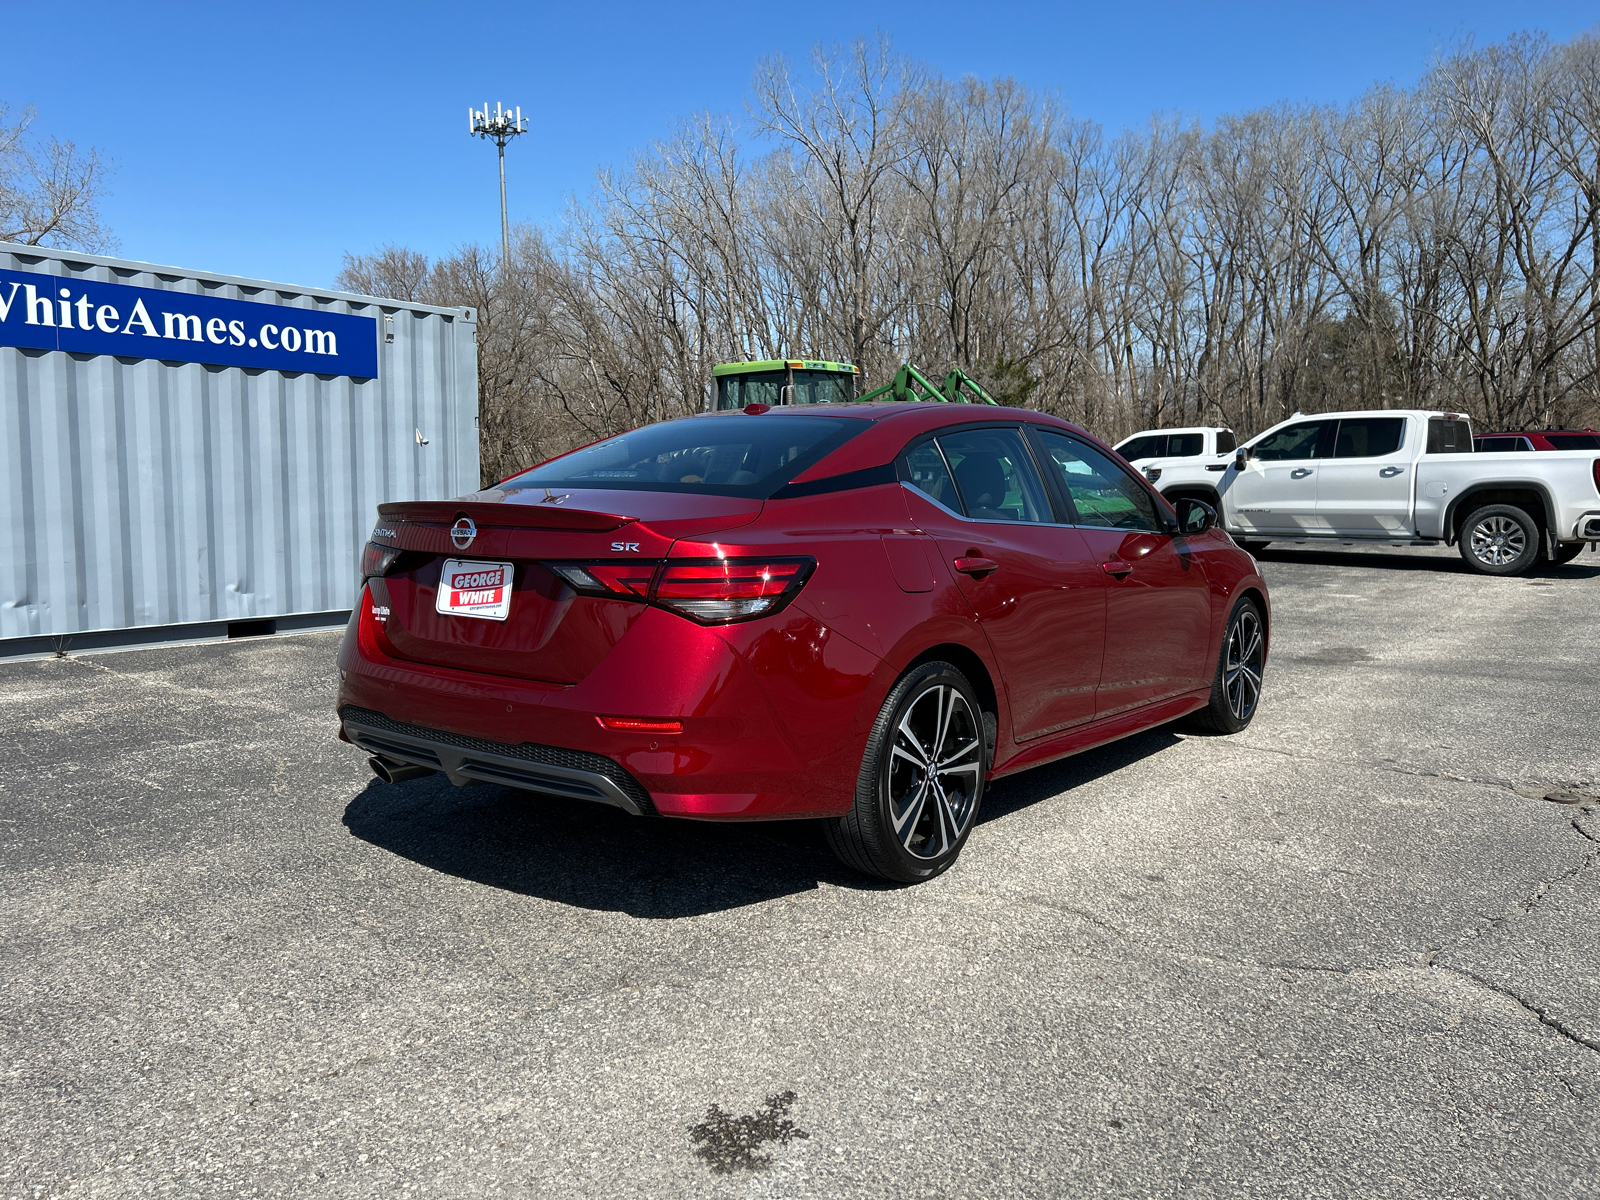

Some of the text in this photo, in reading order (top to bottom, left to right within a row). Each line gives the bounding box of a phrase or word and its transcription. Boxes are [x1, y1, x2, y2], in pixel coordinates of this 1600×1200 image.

[611, 542, 640, 552] SR
[454, 571, 502, 588] GEORGE
[459, 589, 496, 605] WHITE
